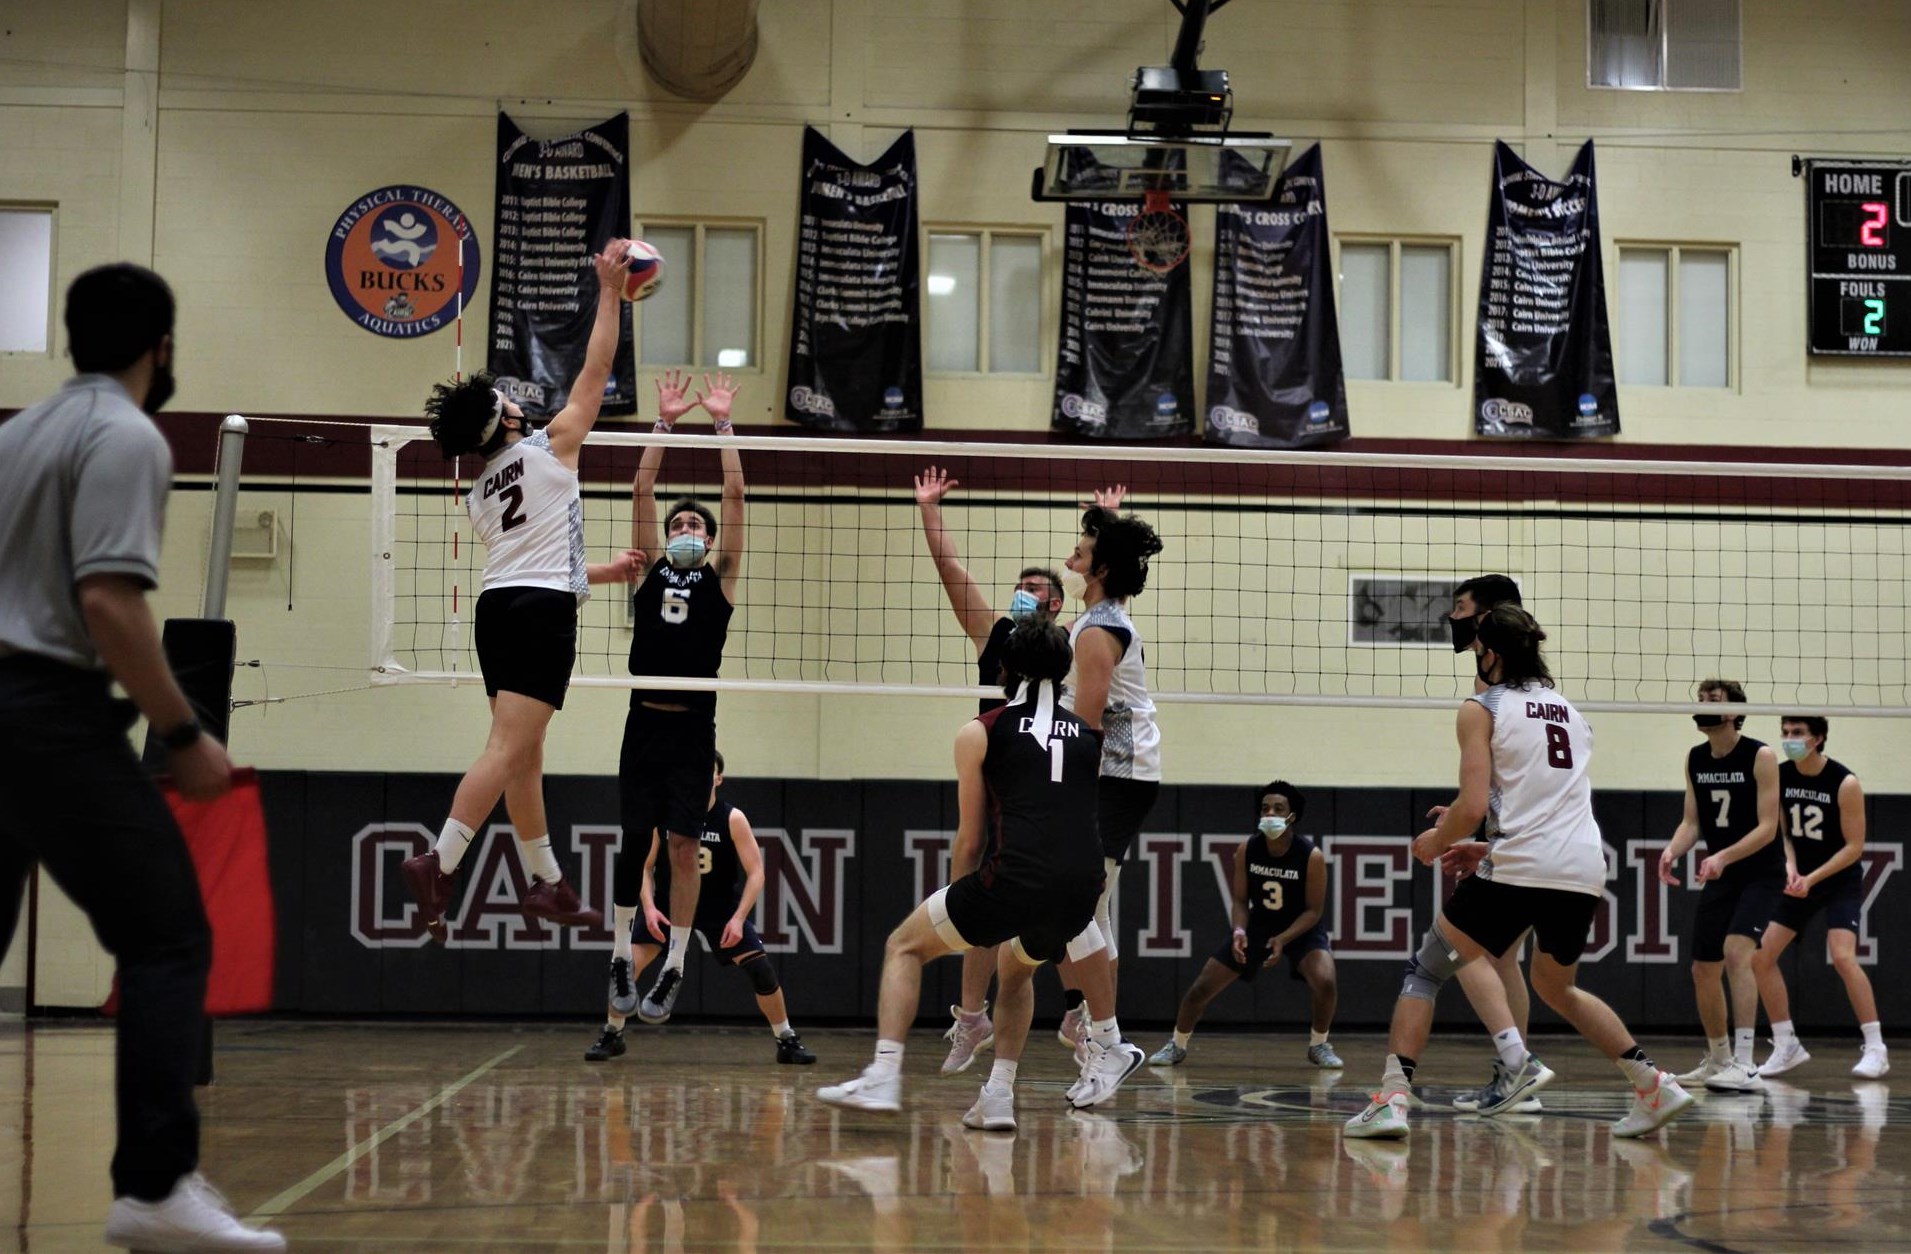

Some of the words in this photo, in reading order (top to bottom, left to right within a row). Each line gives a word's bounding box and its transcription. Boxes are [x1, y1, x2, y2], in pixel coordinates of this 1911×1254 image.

[511, 163, 541, 179] MEN'S
[545, 163, 615, 180] BASKETBALL
[1824, 173, 1883, 195] HOME
[335, 189, 405, 239] PHYSICAL
[1101, 203, 1139, 217] CROSS
[1255, 212, 1291, 226] CROSS
[1860, 203, 1889, 246] 2
[1531, 260, 1574, 272] University
[1847, 253, 1896, 270] BONUS
[360, 270, 445, 292] BUCKS
[1839, 281, 1886, 297] FOULS
[1513, 294, 1534, 306] Cairn
[358, 313, 441, 335] AQUATICS
[1512, 308, 1533, 320] Cairn
[1863, 299, 1885, 335] 2
[1511, 321, 1533, 333] Cairn
[1848, 337, 1879, 351] WON
[483, 457, 525, 501] CAIRN
[498, 484, 527, 533] 2
[660, 587, 692, 625] 6
[1525, 701, 1570, 724] CAIRN
[1018, 717, 1080, 738] CRN
[1545, 723, 1574, 770] 8
[1047, 738, 1064, 783] 1
[1696, 771, 1746, 784] IMMACULATA
[1784, 787, 1832, 804] IMMACULATA
[1710, 789, 1732, 828] 7
[1789, 802, 1824, 841] 12
[1249, 863, 1300, 880] IMMACULATA
[350, 822, 855, 954] CAIN
[1262, 880, 1284, 911] 3
